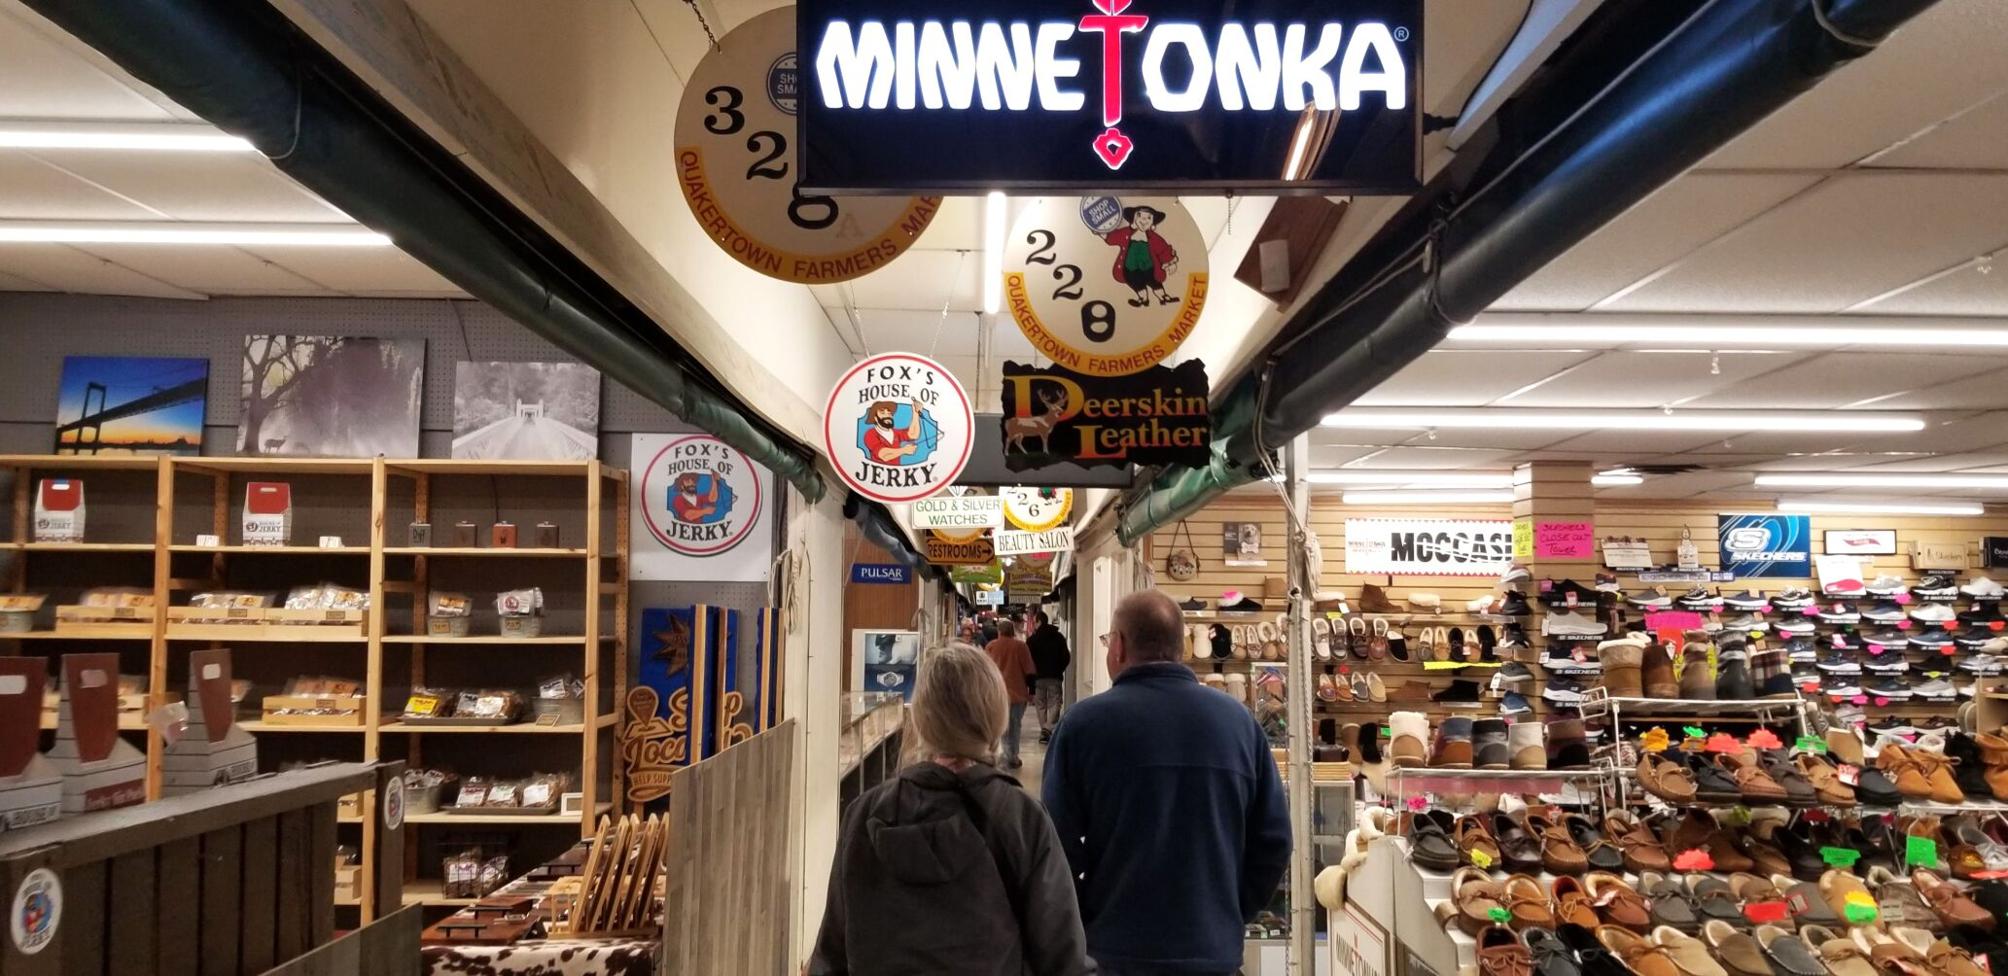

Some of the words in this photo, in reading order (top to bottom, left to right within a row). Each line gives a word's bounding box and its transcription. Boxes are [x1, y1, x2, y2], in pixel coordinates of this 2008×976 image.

[815, 14, 1407, 127] MINNETONKA
[680, 151, 783, 273] QUAKERTOWN
[794, 238, 898, 279] FARMERS
[1088, 199, 1109, 217] SHOP
[1092, 205, 1117, 225] SMALL
[1007, 275, 1081, 367] QUAKERTOWN
[1089, 345, 1165, 372] FARMERS
[1168, 276, 1207, 343] MARKET
[866, 366, 934, 386] FOX'S
[858, 384, 910, 404] HOUSE
[920, 387, 940, 406] OF
[1004, 375, 1208, 424] Deerskin
[1074, 417, 1208, 460] Leather
[675, 443, 730, 460] FOX'S
[668, 458, 710, 475] HOUSE
[717, 461, 734, 476] OF
[855, 462, 938, 488] JERKY
[916, 501, 947, 512] GOLD
[951, 500, 959, 511] &
[963, 499, 1000, 511] SILVER
[929, 514, 988, 526] WATCHES
[667, 520, 732, 541] JERKY
[998, 533, 1035, 551] BEAUTY
[1039, 530, 1069, 549] SALON
[928, 544, 982, 559] RESTROOMS
[1730, 551, 1808, 563] SKECHERS
[861, 567, 903, 578] PULSAR
